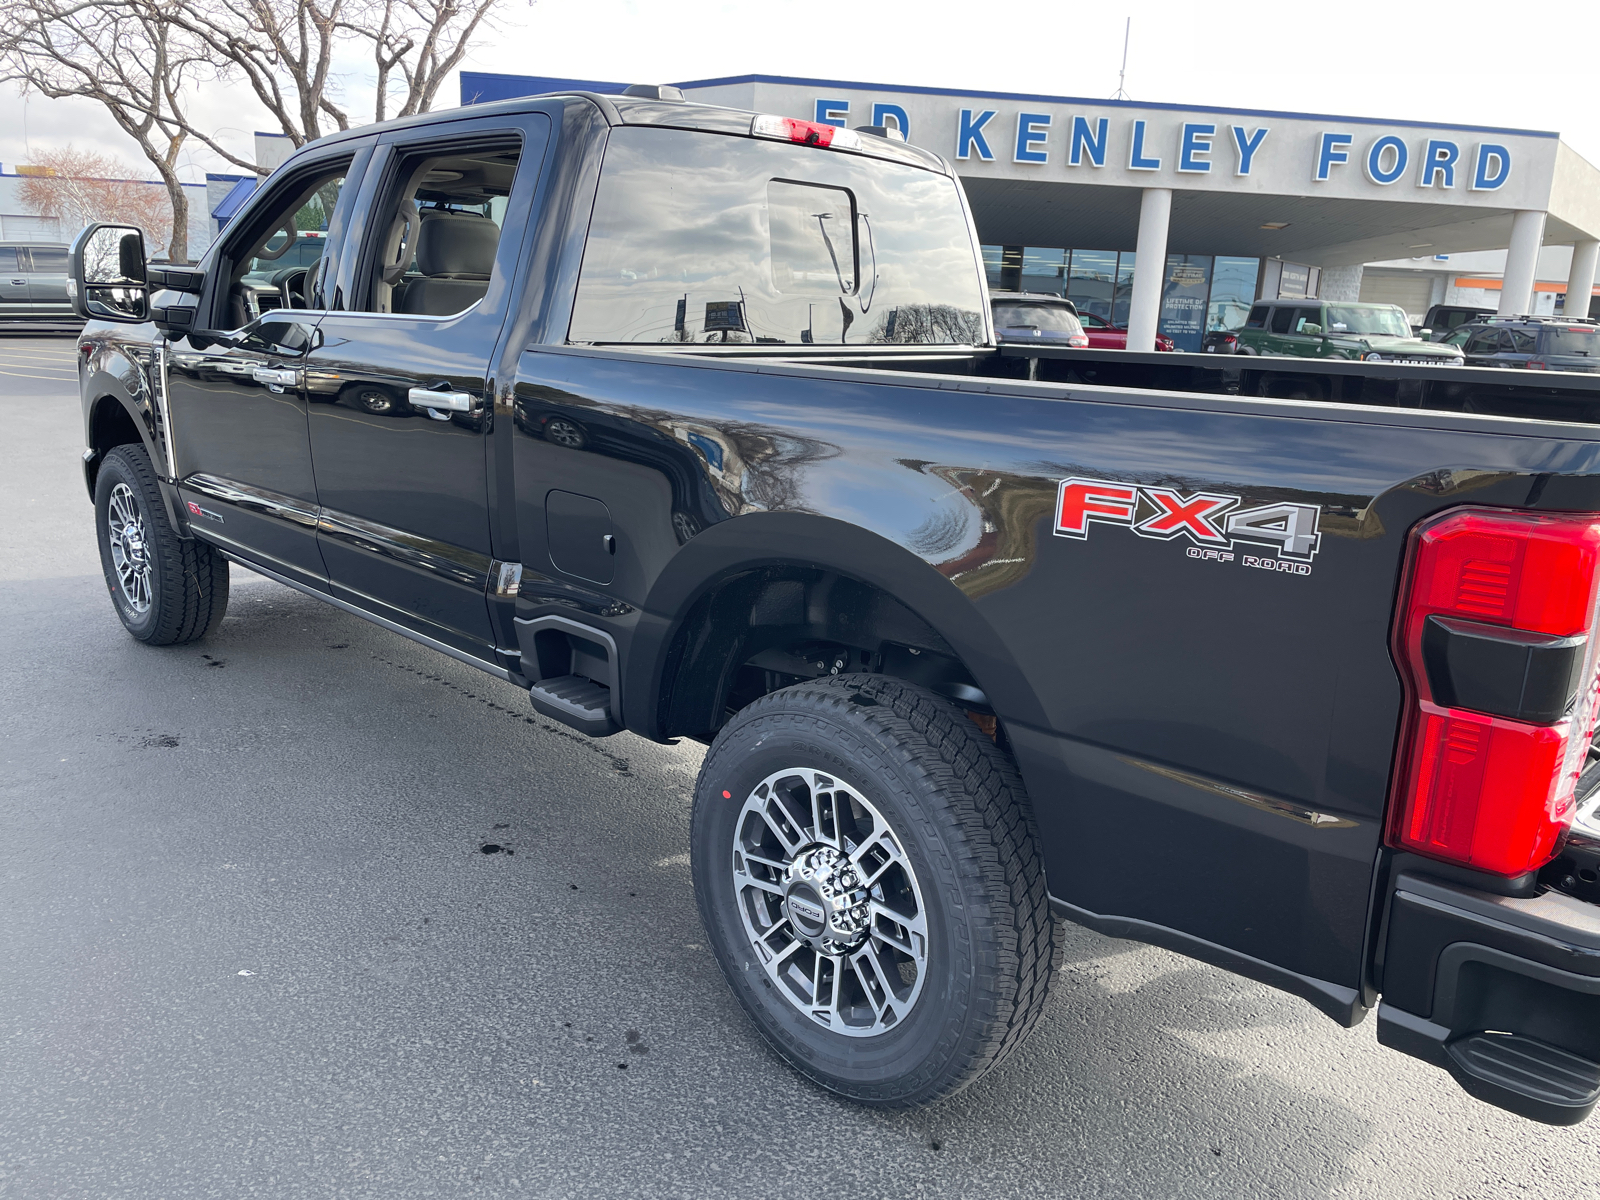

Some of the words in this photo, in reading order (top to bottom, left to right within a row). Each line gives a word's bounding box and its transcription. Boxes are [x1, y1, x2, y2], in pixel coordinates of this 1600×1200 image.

[814, 98, 911, 143] ED
[956, 108, 1271, 177] KENLEY
[1313, 131, 1513, 193] FORD
[1053, 476, 1321, 562] FX4
[1186, 546, 1234, 562] OFF
[1242, 555, 1312, 576] ROAD
[791, 901, 820, 918] FORD
